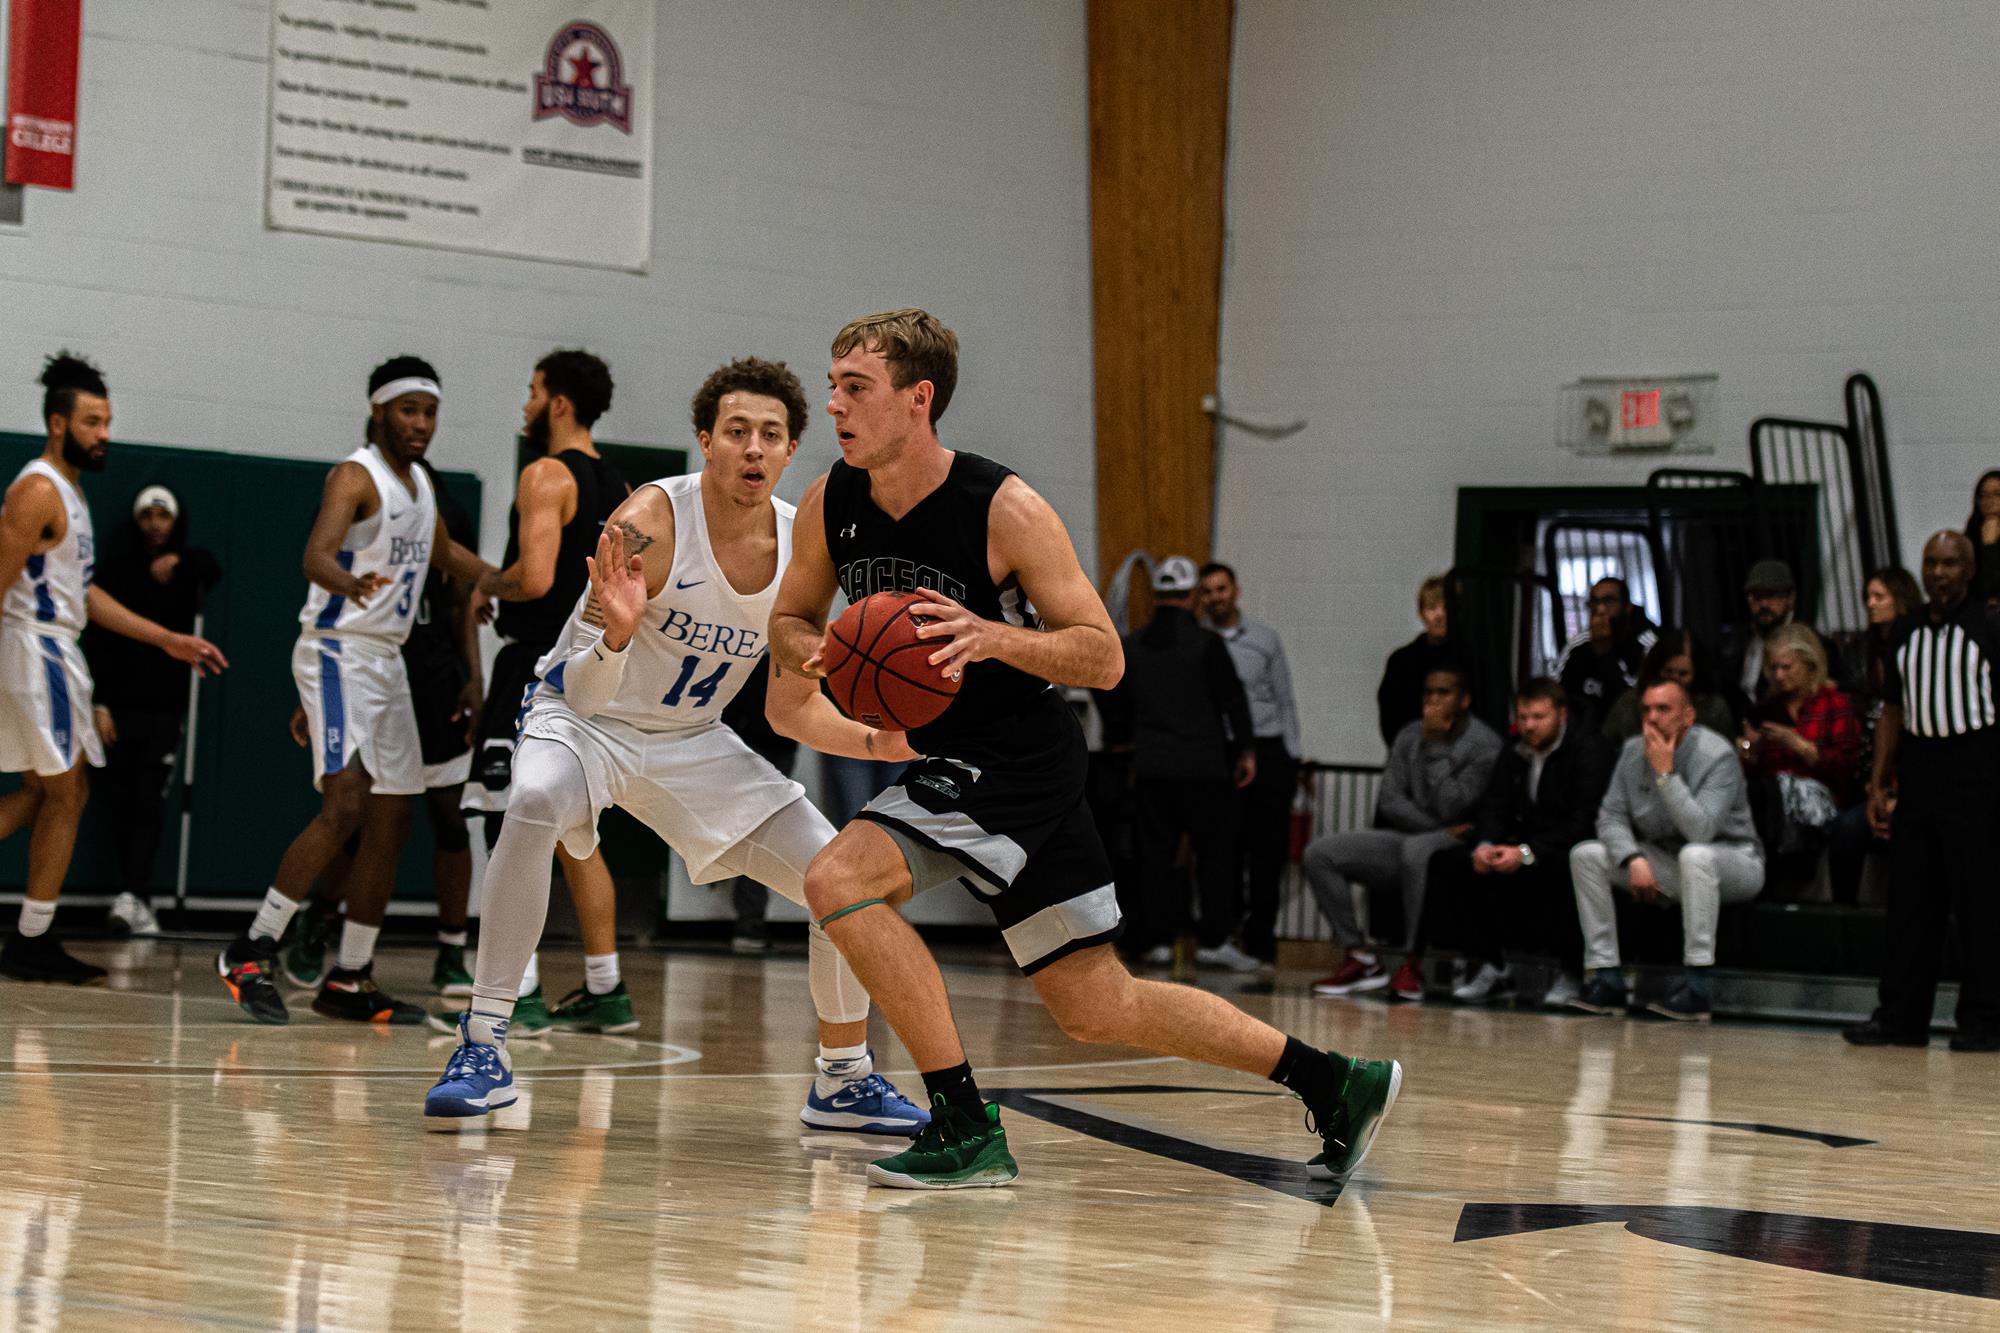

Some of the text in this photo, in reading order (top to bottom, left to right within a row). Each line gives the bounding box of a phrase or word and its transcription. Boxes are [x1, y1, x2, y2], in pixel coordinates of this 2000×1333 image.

[397, 572, 416, 616] 3
[656, 608, 768, 659] BERE
[661, 655, 733, 708] 14
